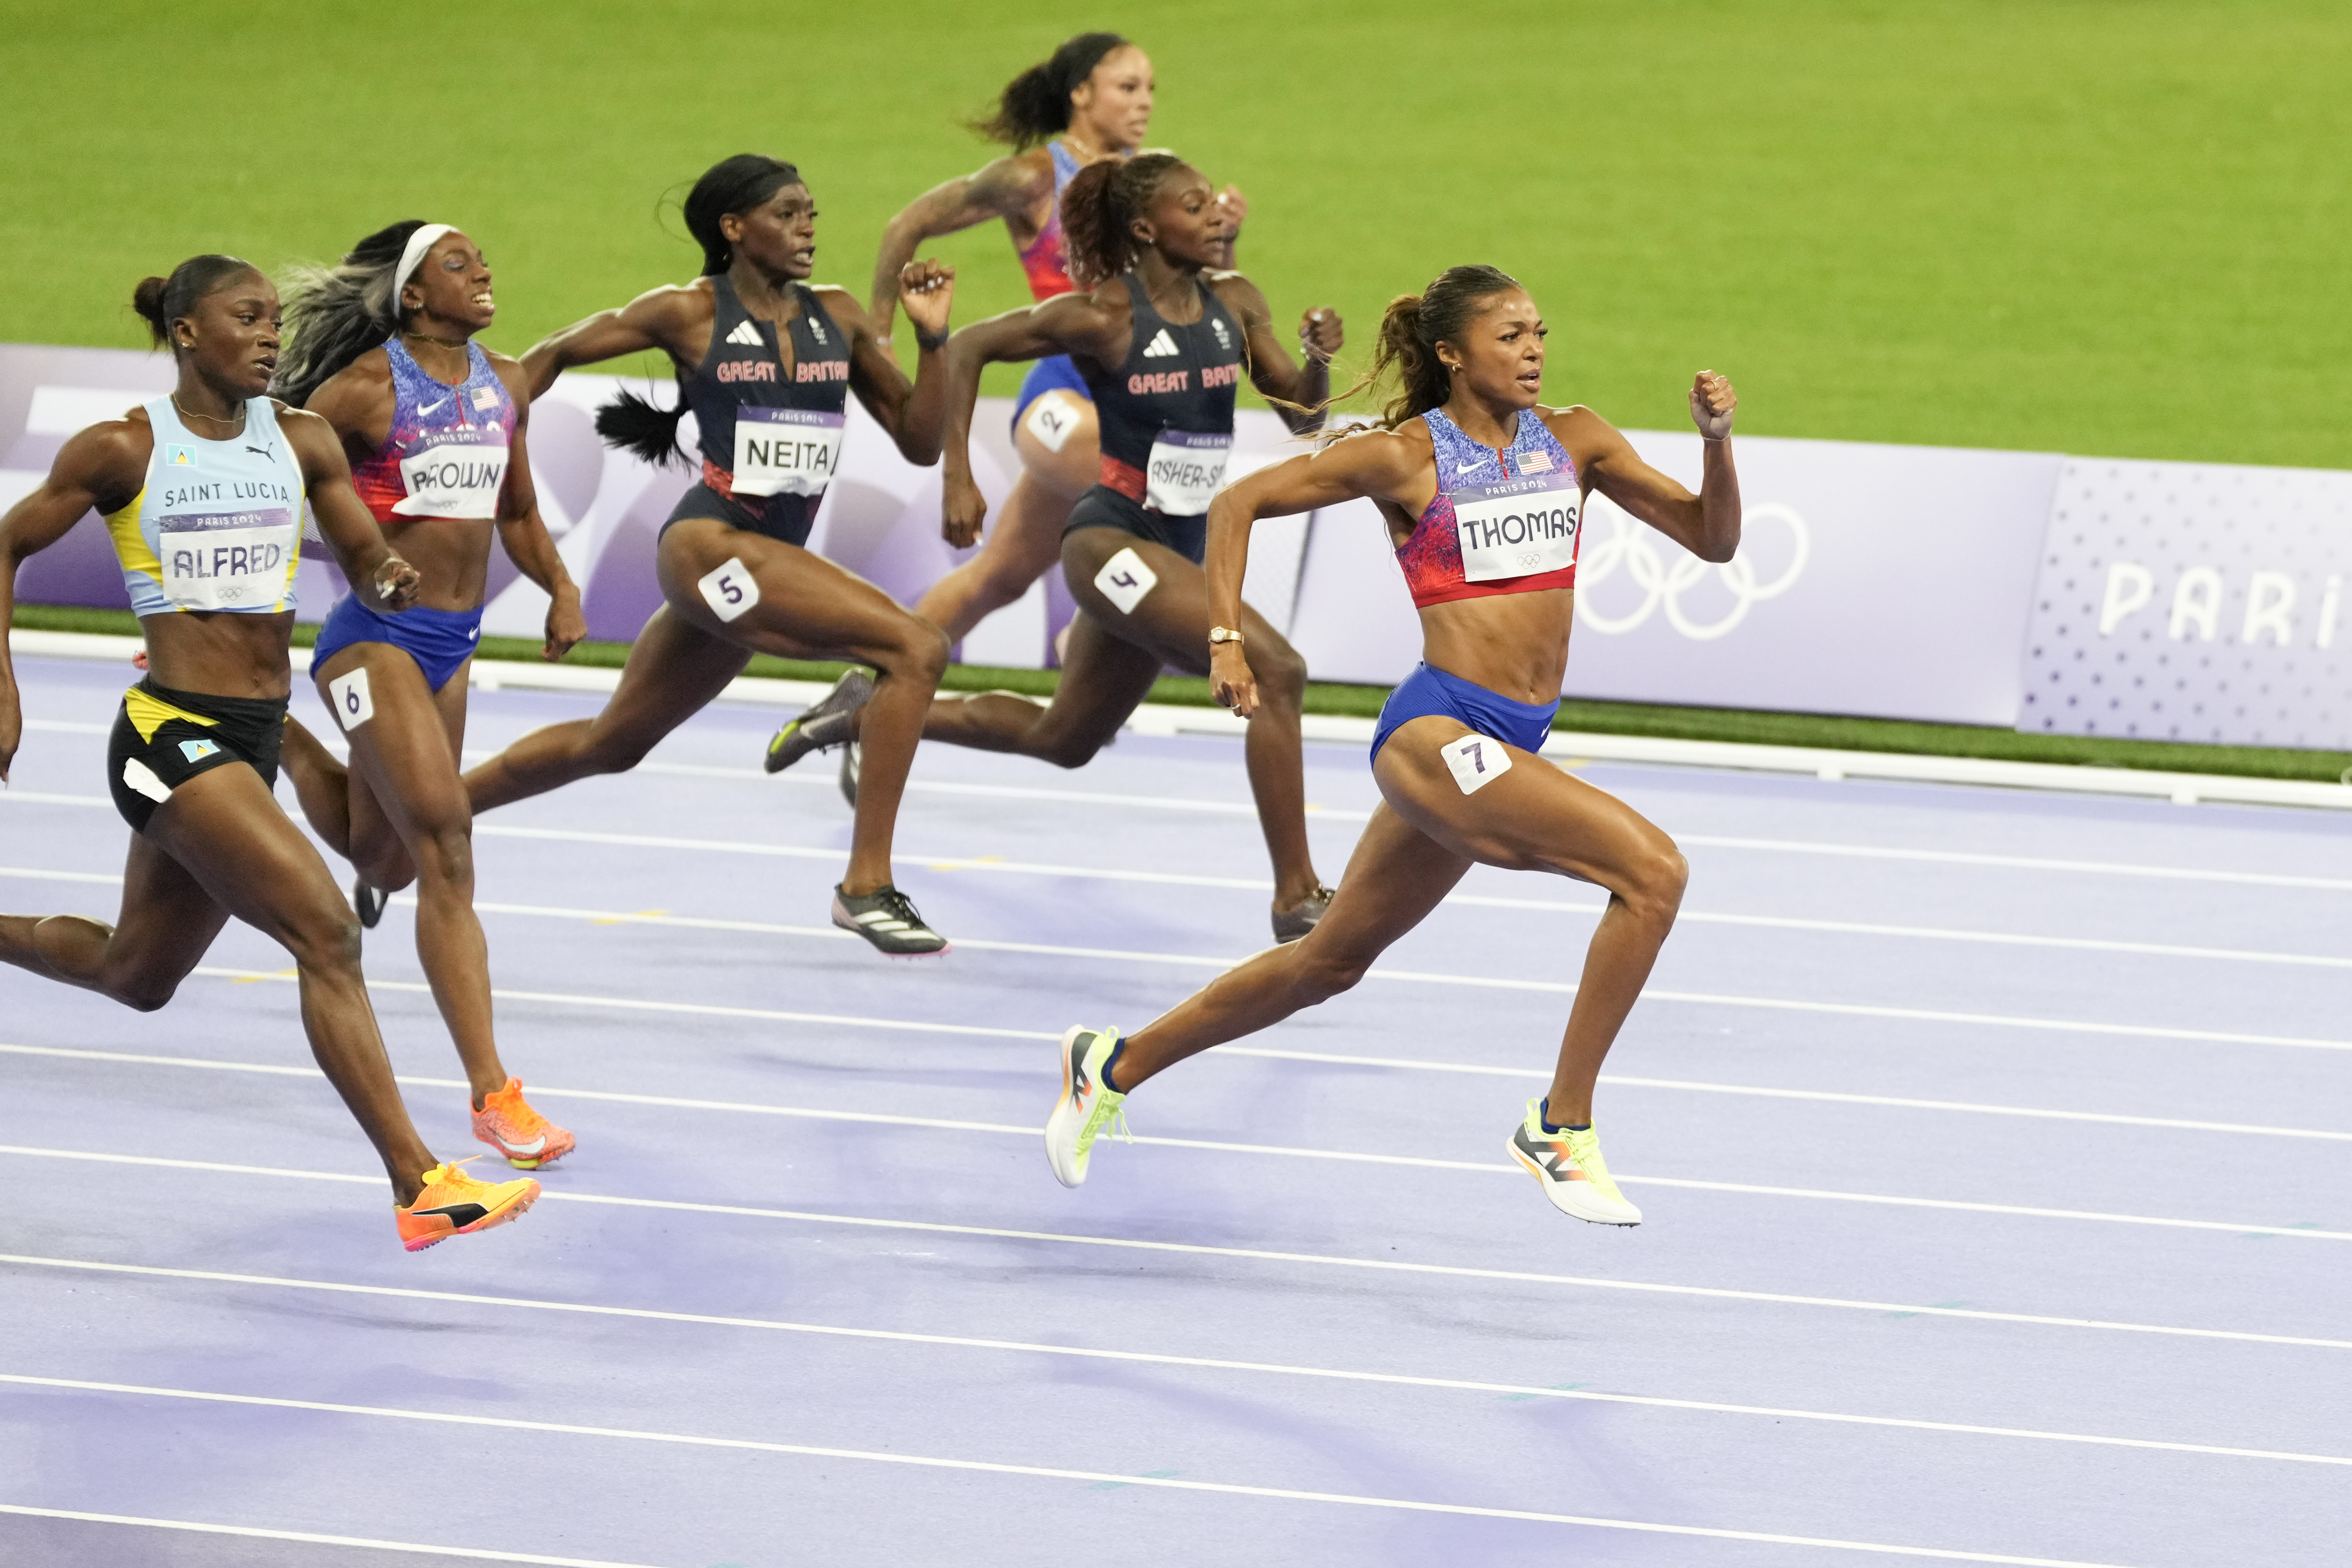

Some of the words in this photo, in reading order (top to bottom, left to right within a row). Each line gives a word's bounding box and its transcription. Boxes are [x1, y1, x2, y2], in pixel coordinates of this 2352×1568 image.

[717, 360, 776, 383] GREAT
[1128, 371, 1188, 395] GREAT
[1041, 410, 1063, 434] 2
[747, 439, 828, 470] NEITA
[165, 483, 221, 507] SAINT
[234, 483, 289, 503] LUCIA
[1522, 480, 1548, 490] 2024
[232, 515, 262, 525] 2024
[1463, 507, 1576, 550] THOMAS
[173, 543, 280, 579] ALFRED
[718, 574, 743, 604] 5
[1110, 570, 1139, 588] 4
[346, 684, 360, 714] 6
[1460, 742, 1486, 774] 7
